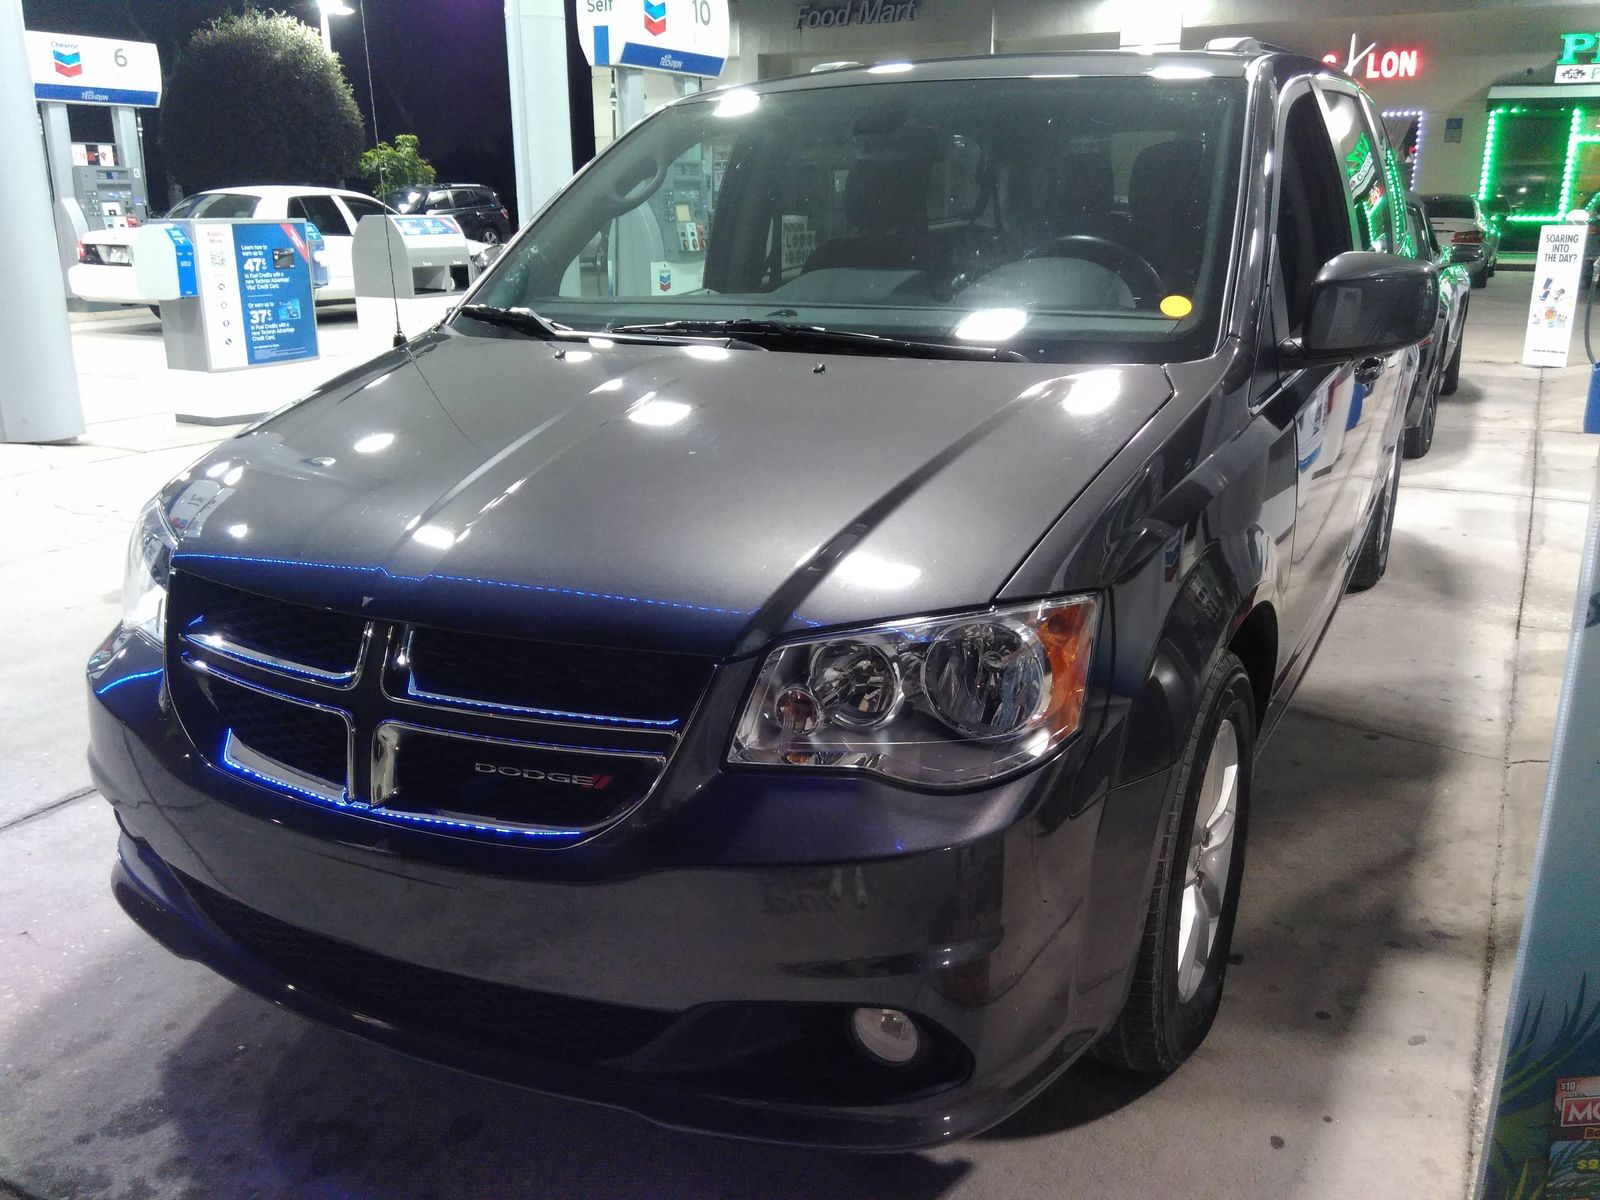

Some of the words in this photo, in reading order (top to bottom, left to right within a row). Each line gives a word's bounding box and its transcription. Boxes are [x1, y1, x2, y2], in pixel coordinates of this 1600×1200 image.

[587, 0, 613, 12] Self
[692, 0, 711, 26] 10
[794, 0, 852, 30] Food
[858, 0, 916, 24] Mart
[114, 47, 128, 67] 6
[1546, 234, 1579, 244] SOARING
[1552, 244, 1570, 253] INTO
[1544, 254, 1557, 263] THE
[1558, 253, 1577, 263] DAY?
[475, 762, 594, 786] DODGE
[1561, 1081, 1576, 1092] $10
